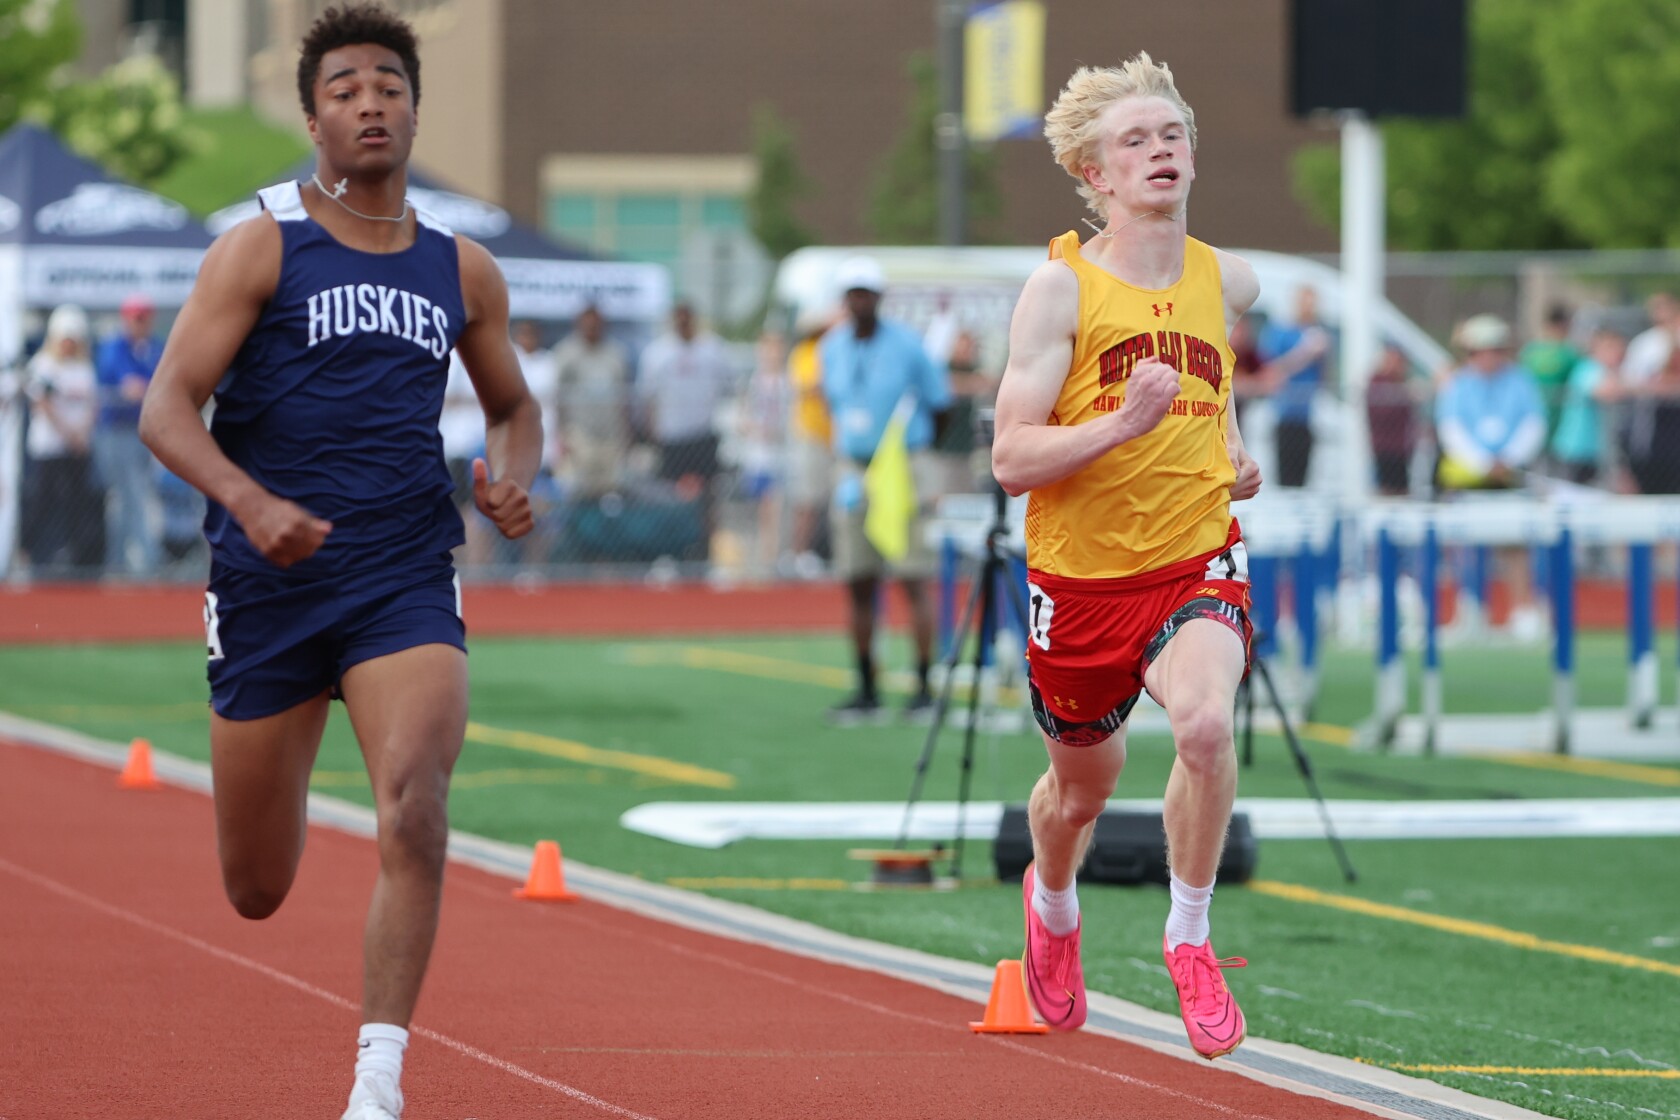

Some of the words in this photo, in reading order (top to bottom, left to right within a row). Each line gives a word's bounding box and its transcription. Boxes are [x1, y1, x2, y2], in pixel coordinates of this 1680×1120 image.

[307, 283, 449, 360] HUSKIES
[1099, 332, 1155, 389] UNITED
[1157, 330, 1183, 373] CLAY
[1167, 399, 1188, 416] ARK
[1031, 594, 1043, 640] 1
